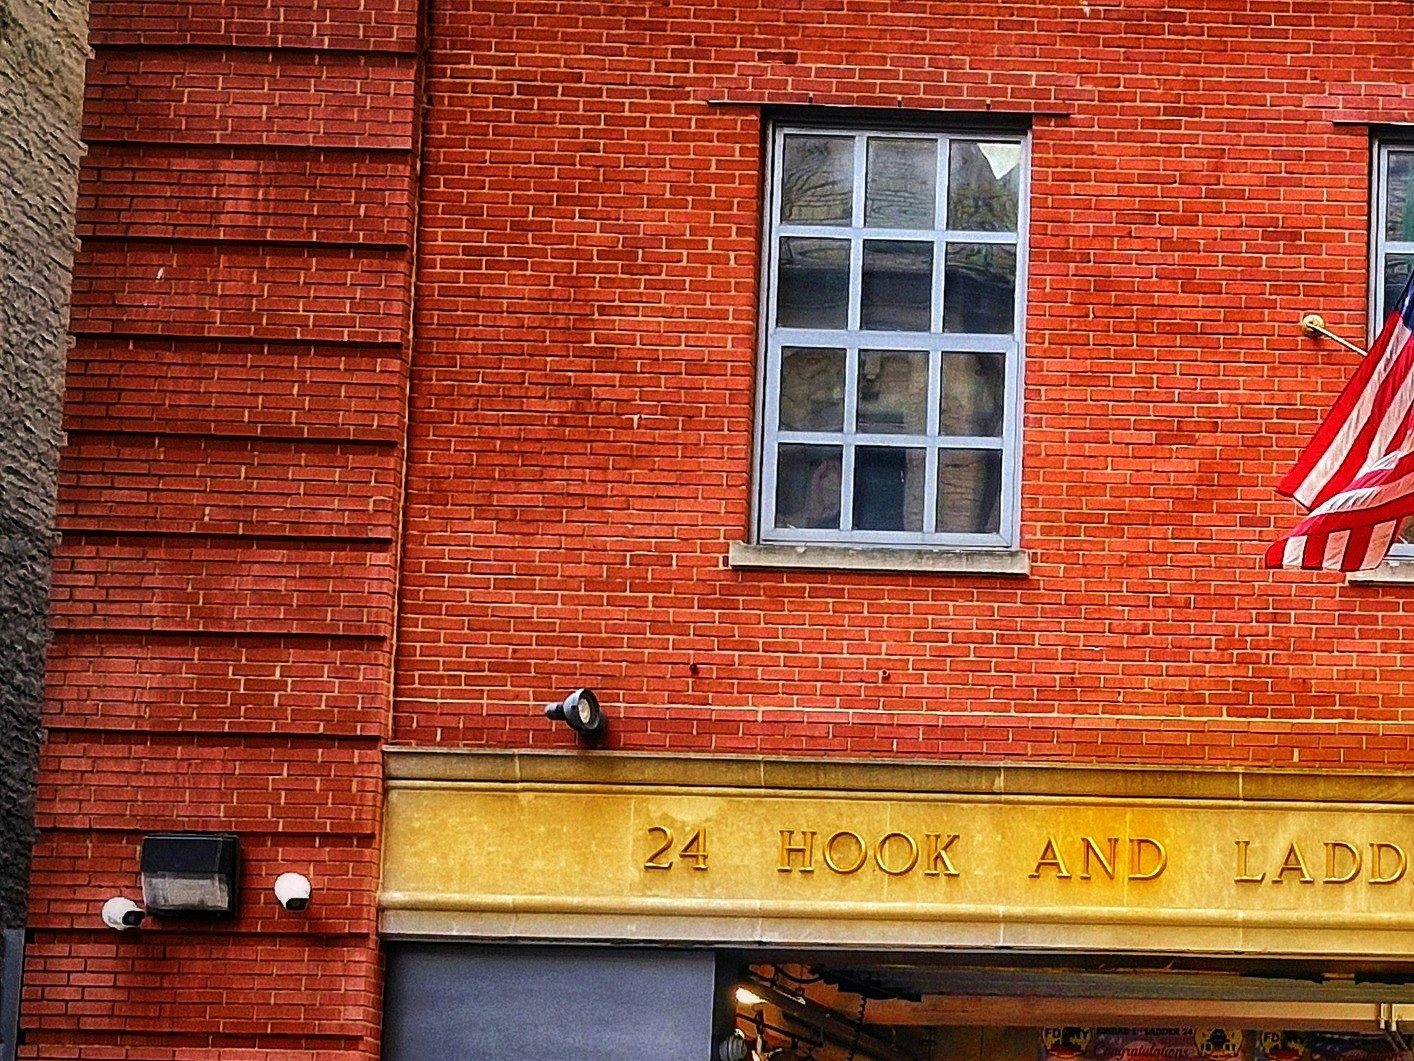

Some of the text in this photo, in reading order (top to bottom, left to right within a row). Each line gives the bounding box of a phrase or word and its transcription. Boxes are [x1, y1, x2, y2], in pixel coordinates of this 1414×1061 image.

[643, 825, 709, 871] 24
[777, 829, 960, 877] HOOK
[1027, 836, 1168, 881] AND
[1093, 1043, 1189, 1060] Congratulations
